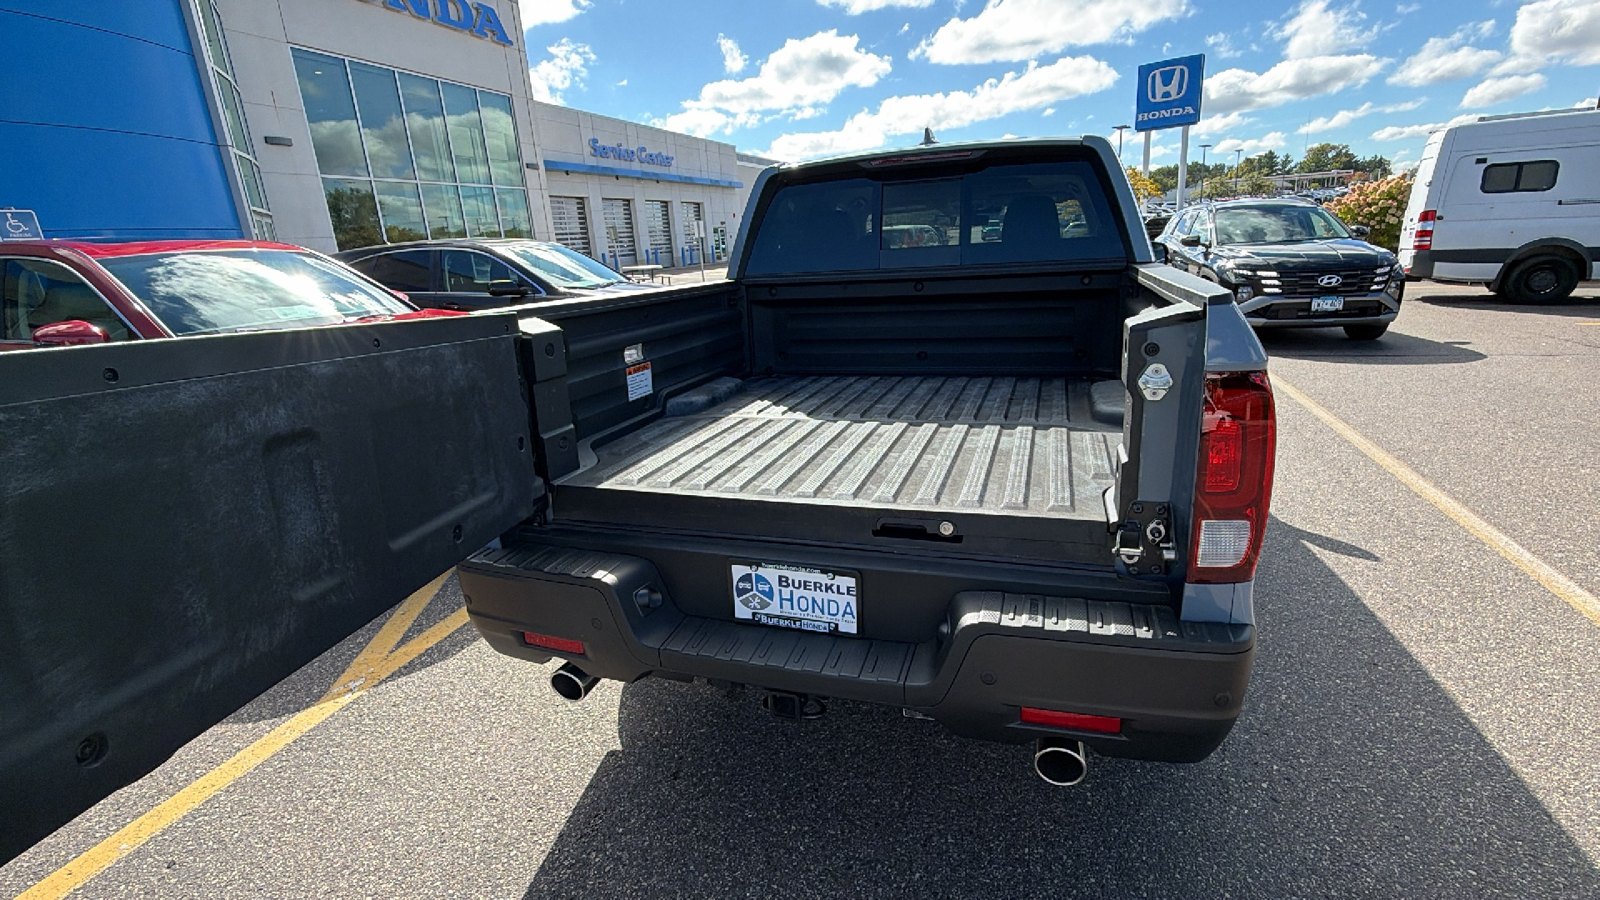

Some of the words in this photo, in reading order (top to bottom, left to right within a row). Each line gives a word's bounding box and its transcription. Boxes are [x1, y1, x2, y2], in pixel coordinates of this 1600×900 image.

[1137, 106, 1196, 121] HONDA
[588, 137, 637, 162] Service
[637, 146, 674, 167] Center
[778, 574, 856, 597] BUERKLE
[778, 588, 856, 620] HONDA
[761, 616, 801, 628] BUERKLE
[802, 620, 828, 632] HONDA
